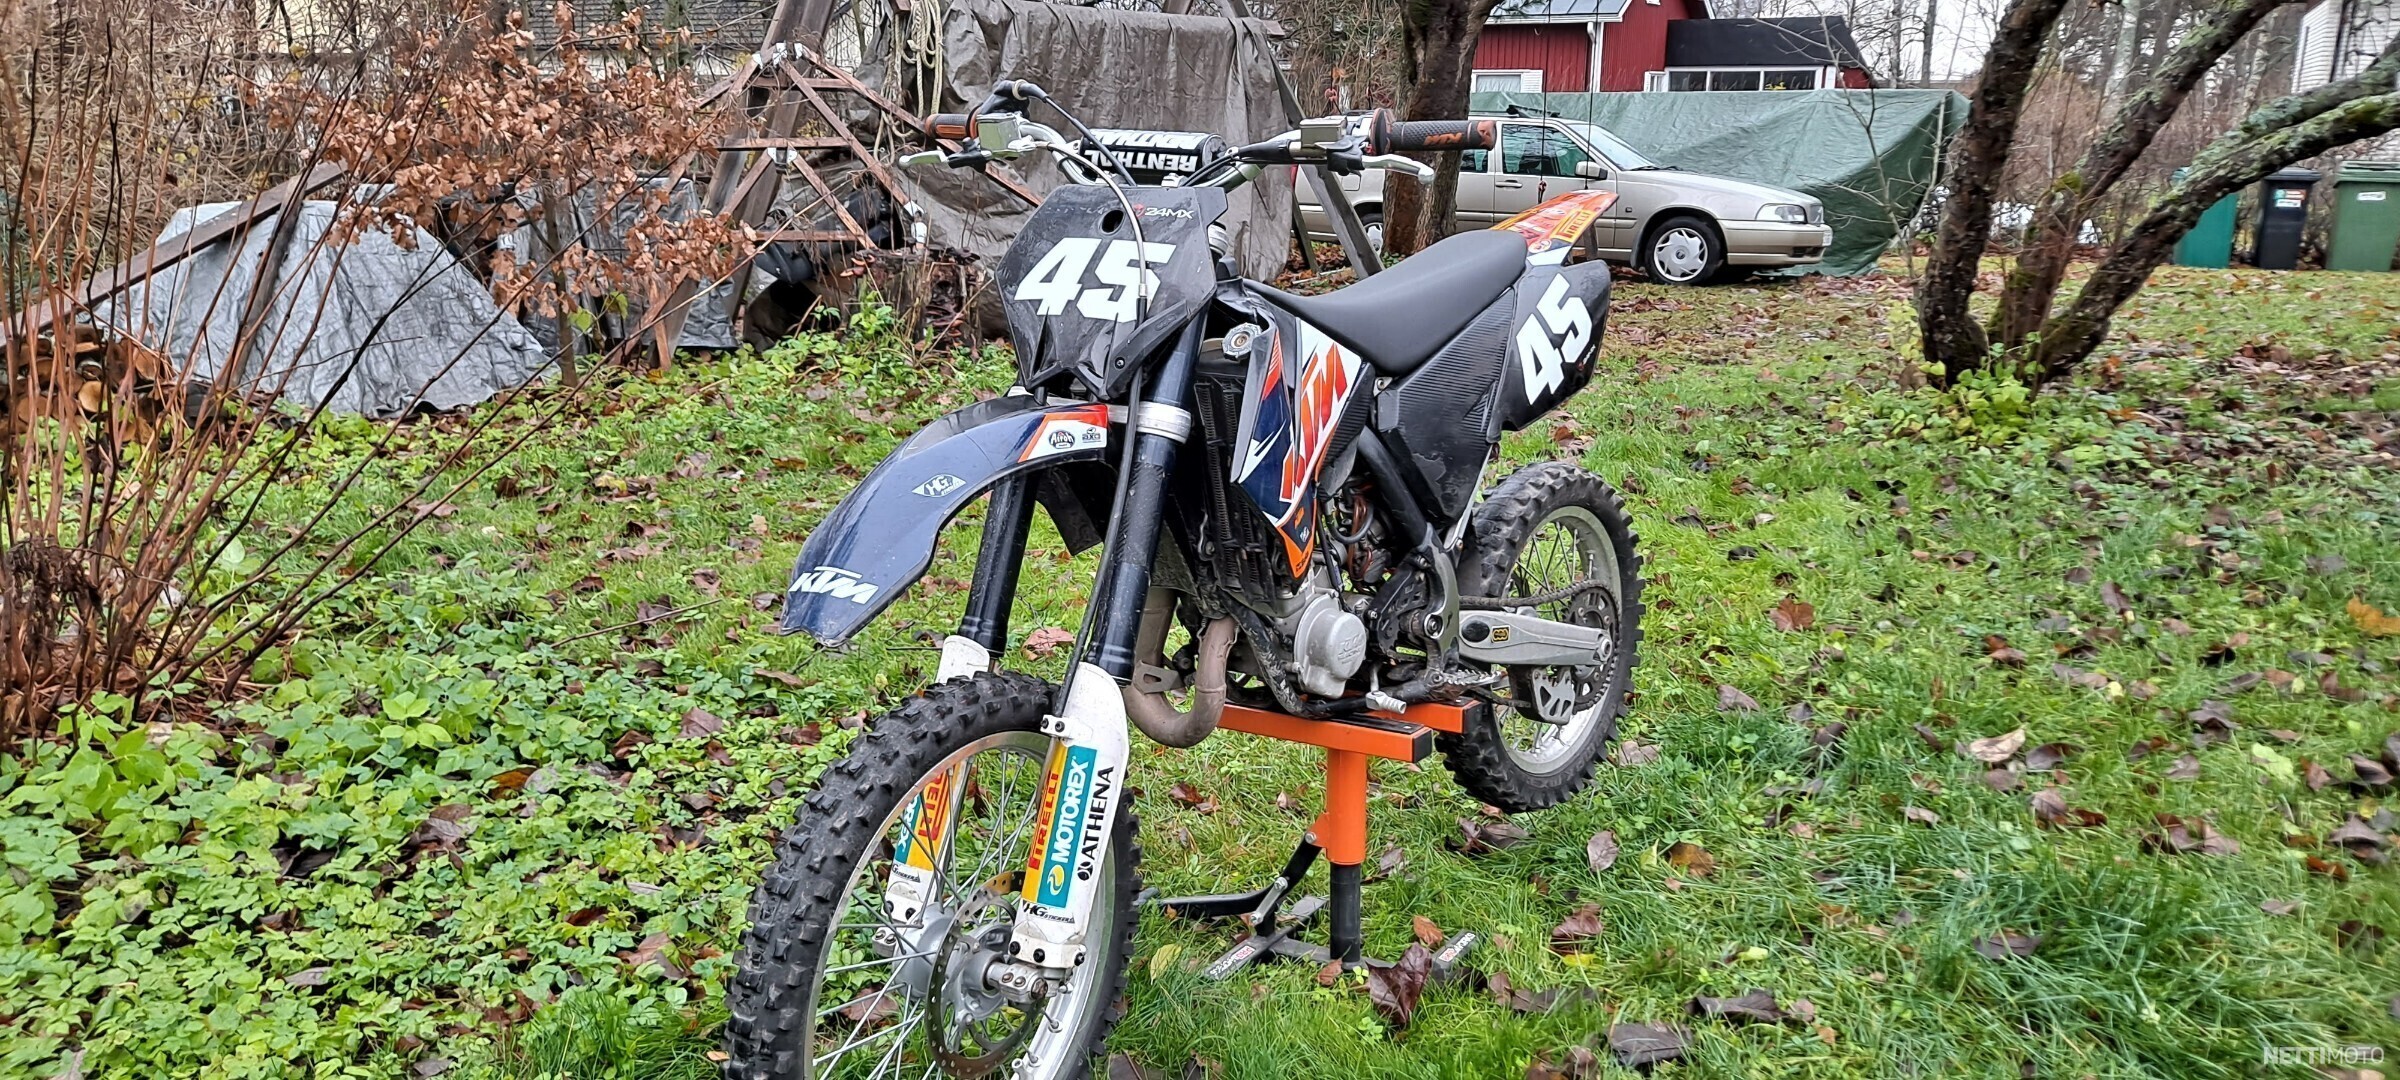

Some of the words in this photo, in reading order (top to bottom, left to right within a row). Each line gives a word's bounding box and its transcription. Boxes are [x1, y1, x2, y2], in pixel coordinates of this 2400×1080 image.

[1145, 207, 1195, 219] 24MX
[1559, 211, 1592, 239] PIRELLI
[1013, 237, 1177, 323] 45
[1515, 272, 1593, 406] 45
[788, 566, 879, 605] KTM
[1028, 769, 1059, 870] PIRELLI
[1051, 760, 1089, 864] MOTOREX
[1081, 766, 1115, 860] ATHENA
